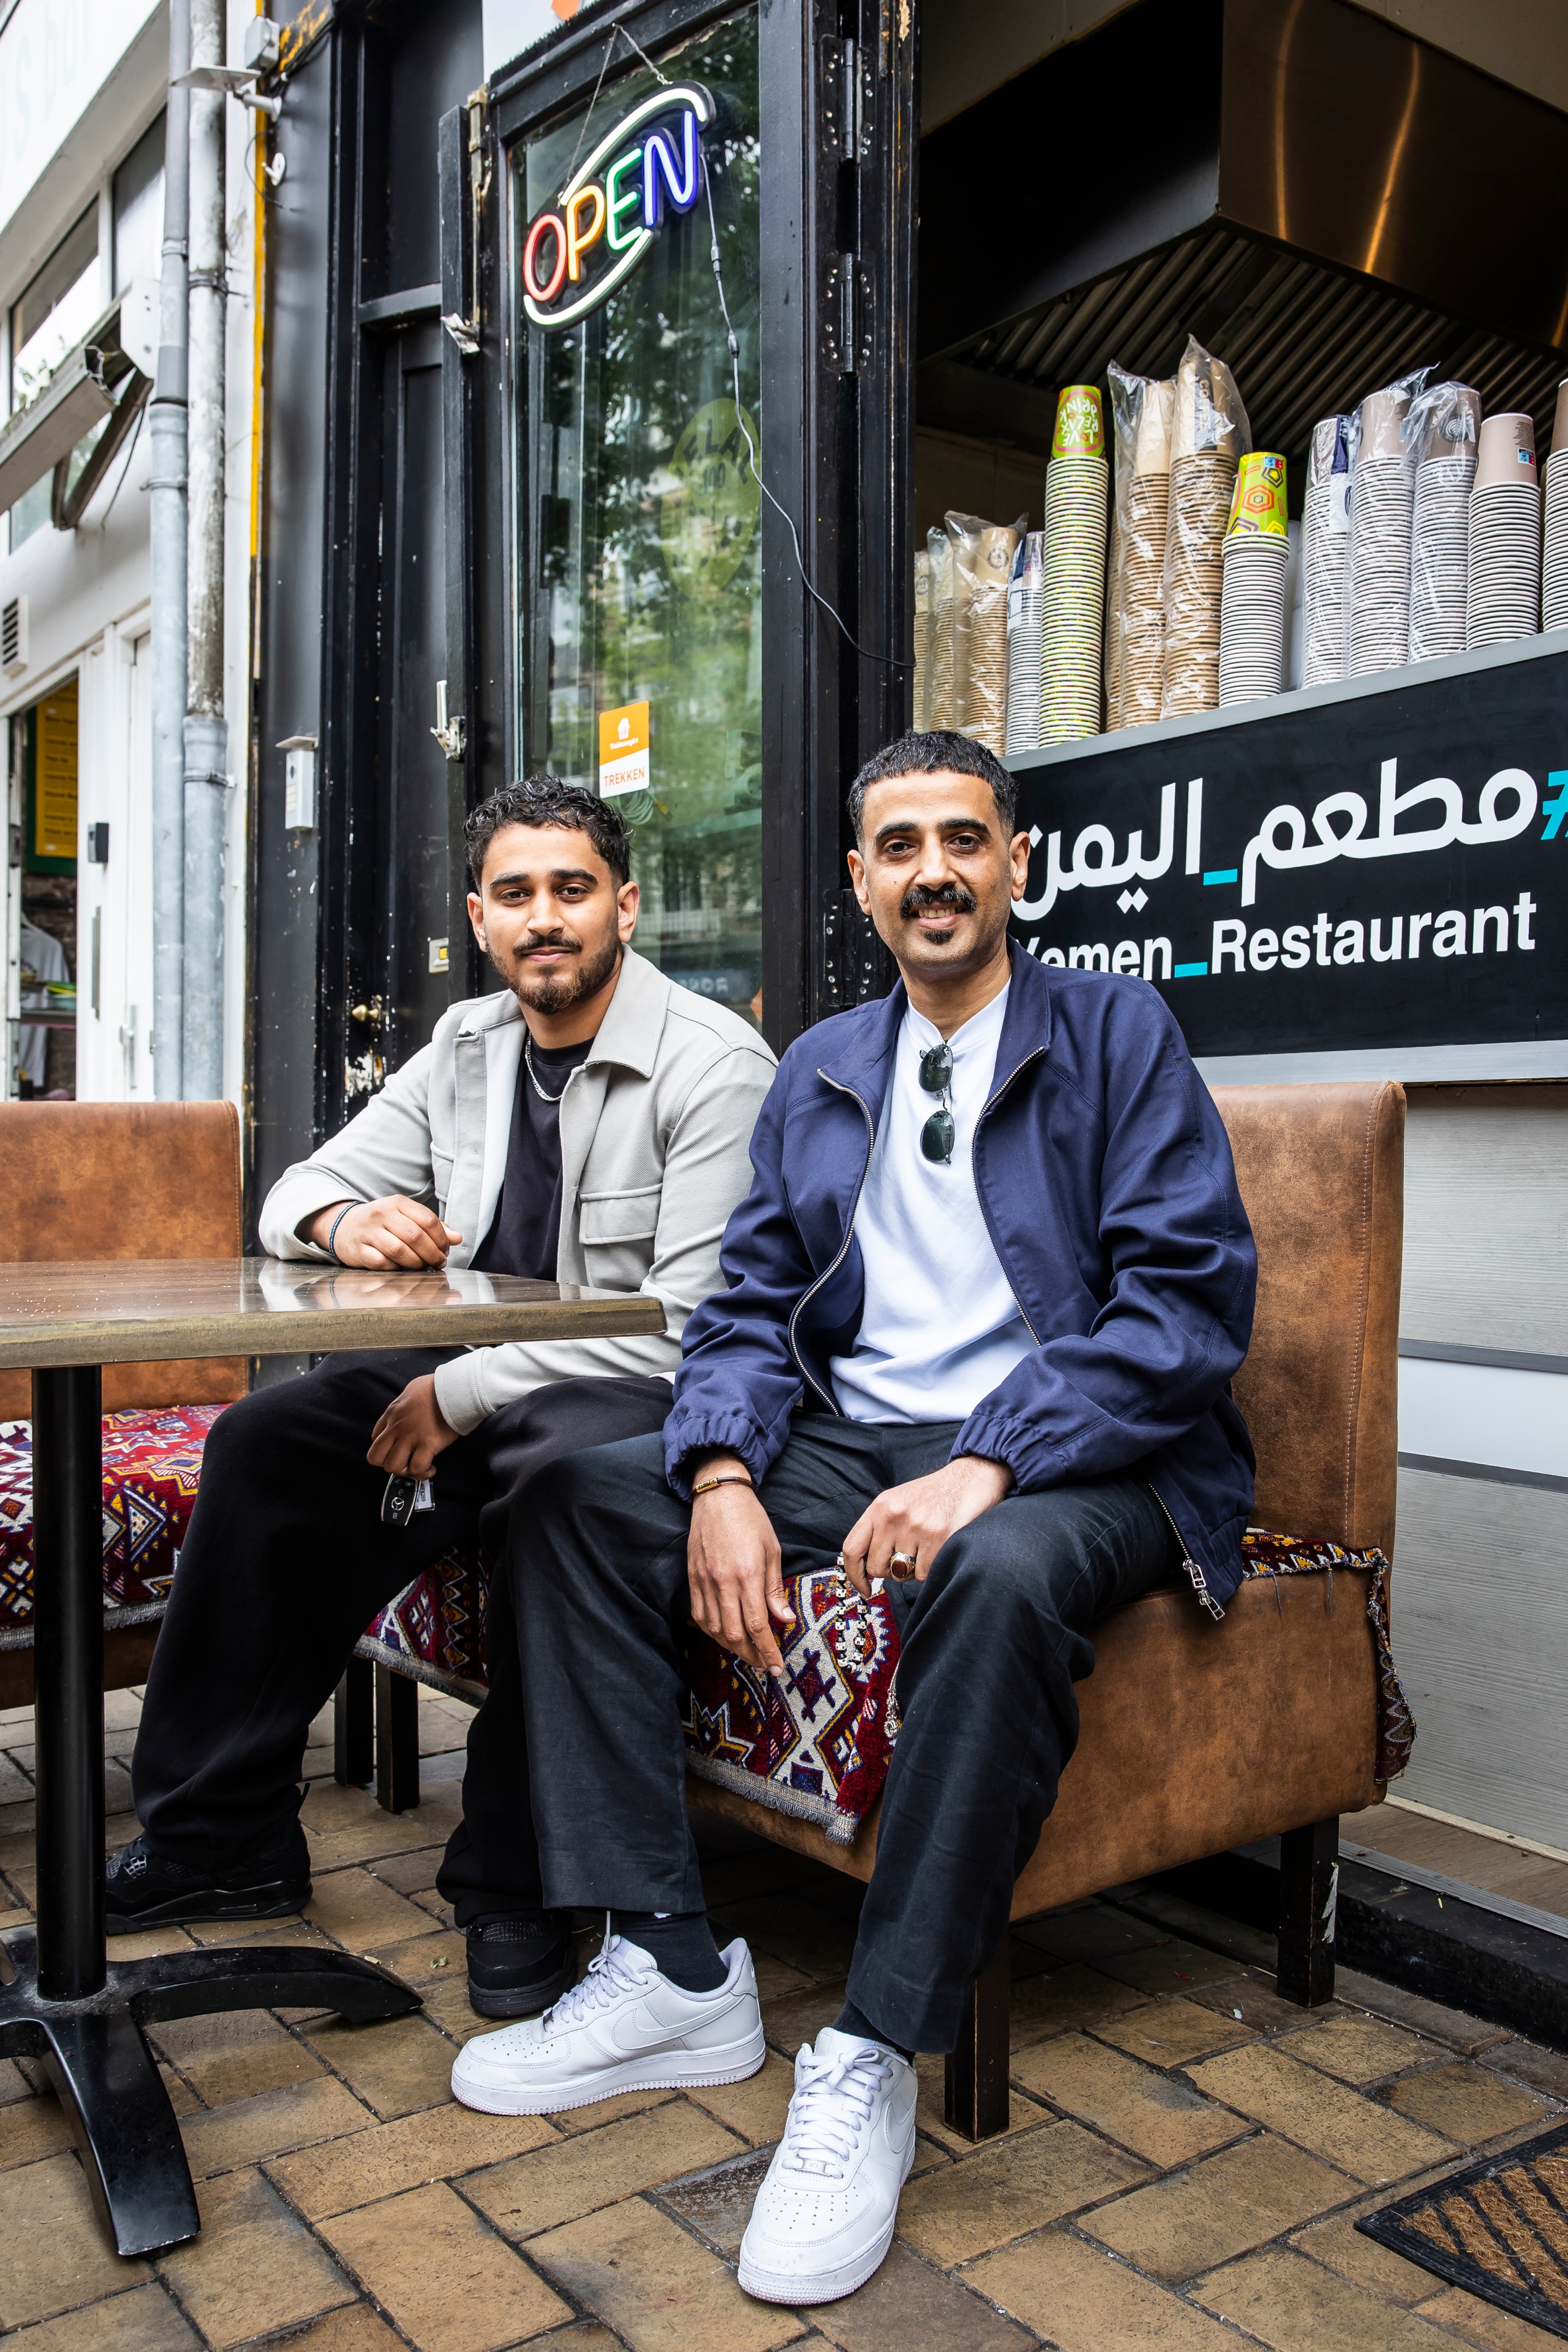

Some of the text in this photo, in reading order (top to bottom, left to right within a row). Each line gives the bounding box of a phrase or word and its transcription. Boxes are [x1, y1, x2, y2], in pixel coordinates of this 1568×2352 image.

[523, 110, 698, 301] OPEN
[1061, 415, 1099, 435] RELAX
[604, 767, 645, 787] TREKKEN
